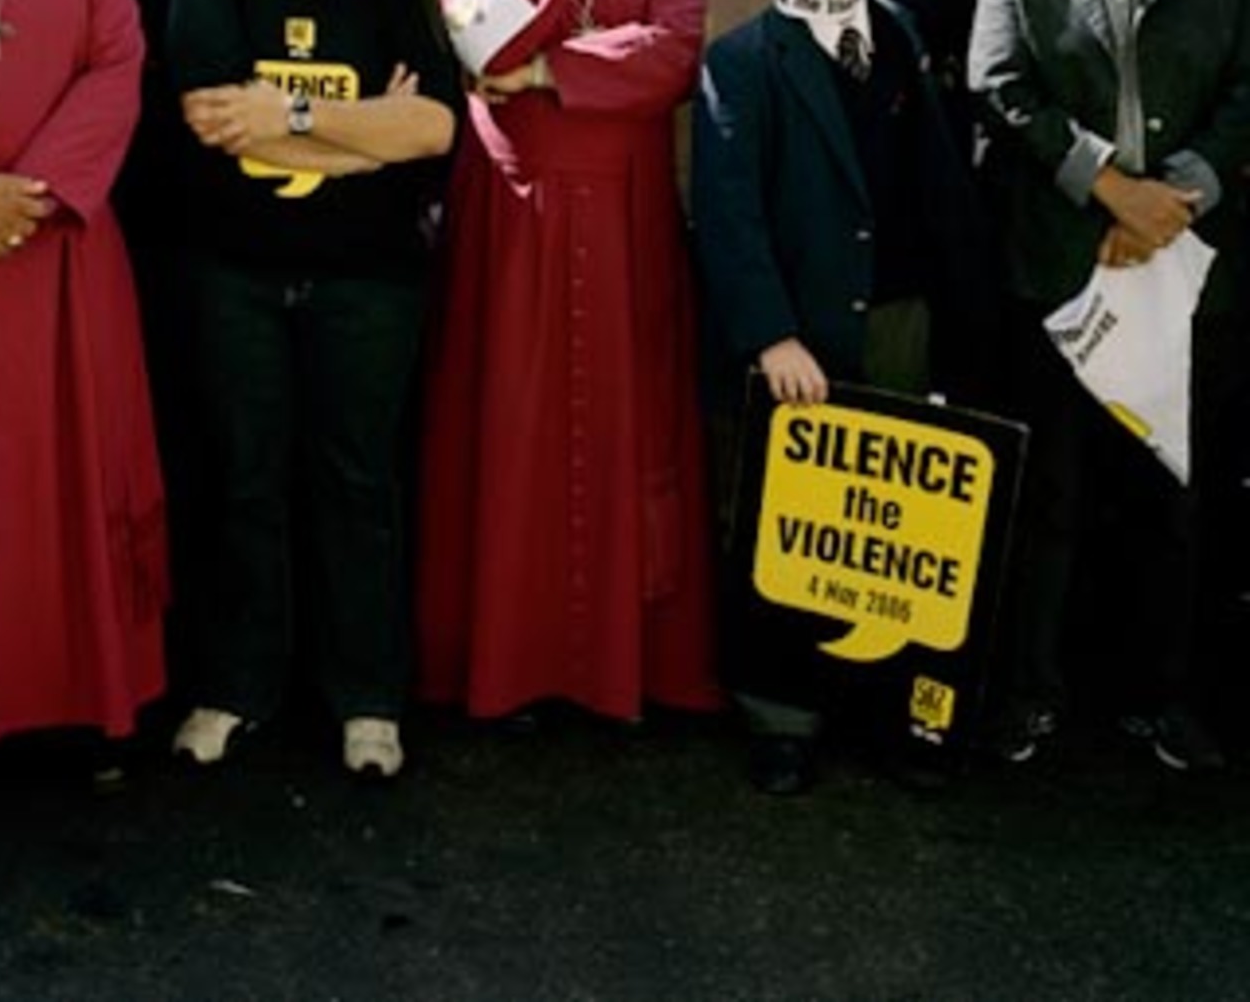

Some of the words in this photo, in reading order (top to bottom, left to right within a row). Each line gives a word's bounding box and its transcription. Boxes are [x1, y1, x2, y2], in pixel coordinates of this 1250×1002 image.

[783, 417, 979, 505] SILENCE
[842, 485, 903, 530] the
[777, 515, 961, 598] VIOLENCE
[807, 575, 819, 598] 4
